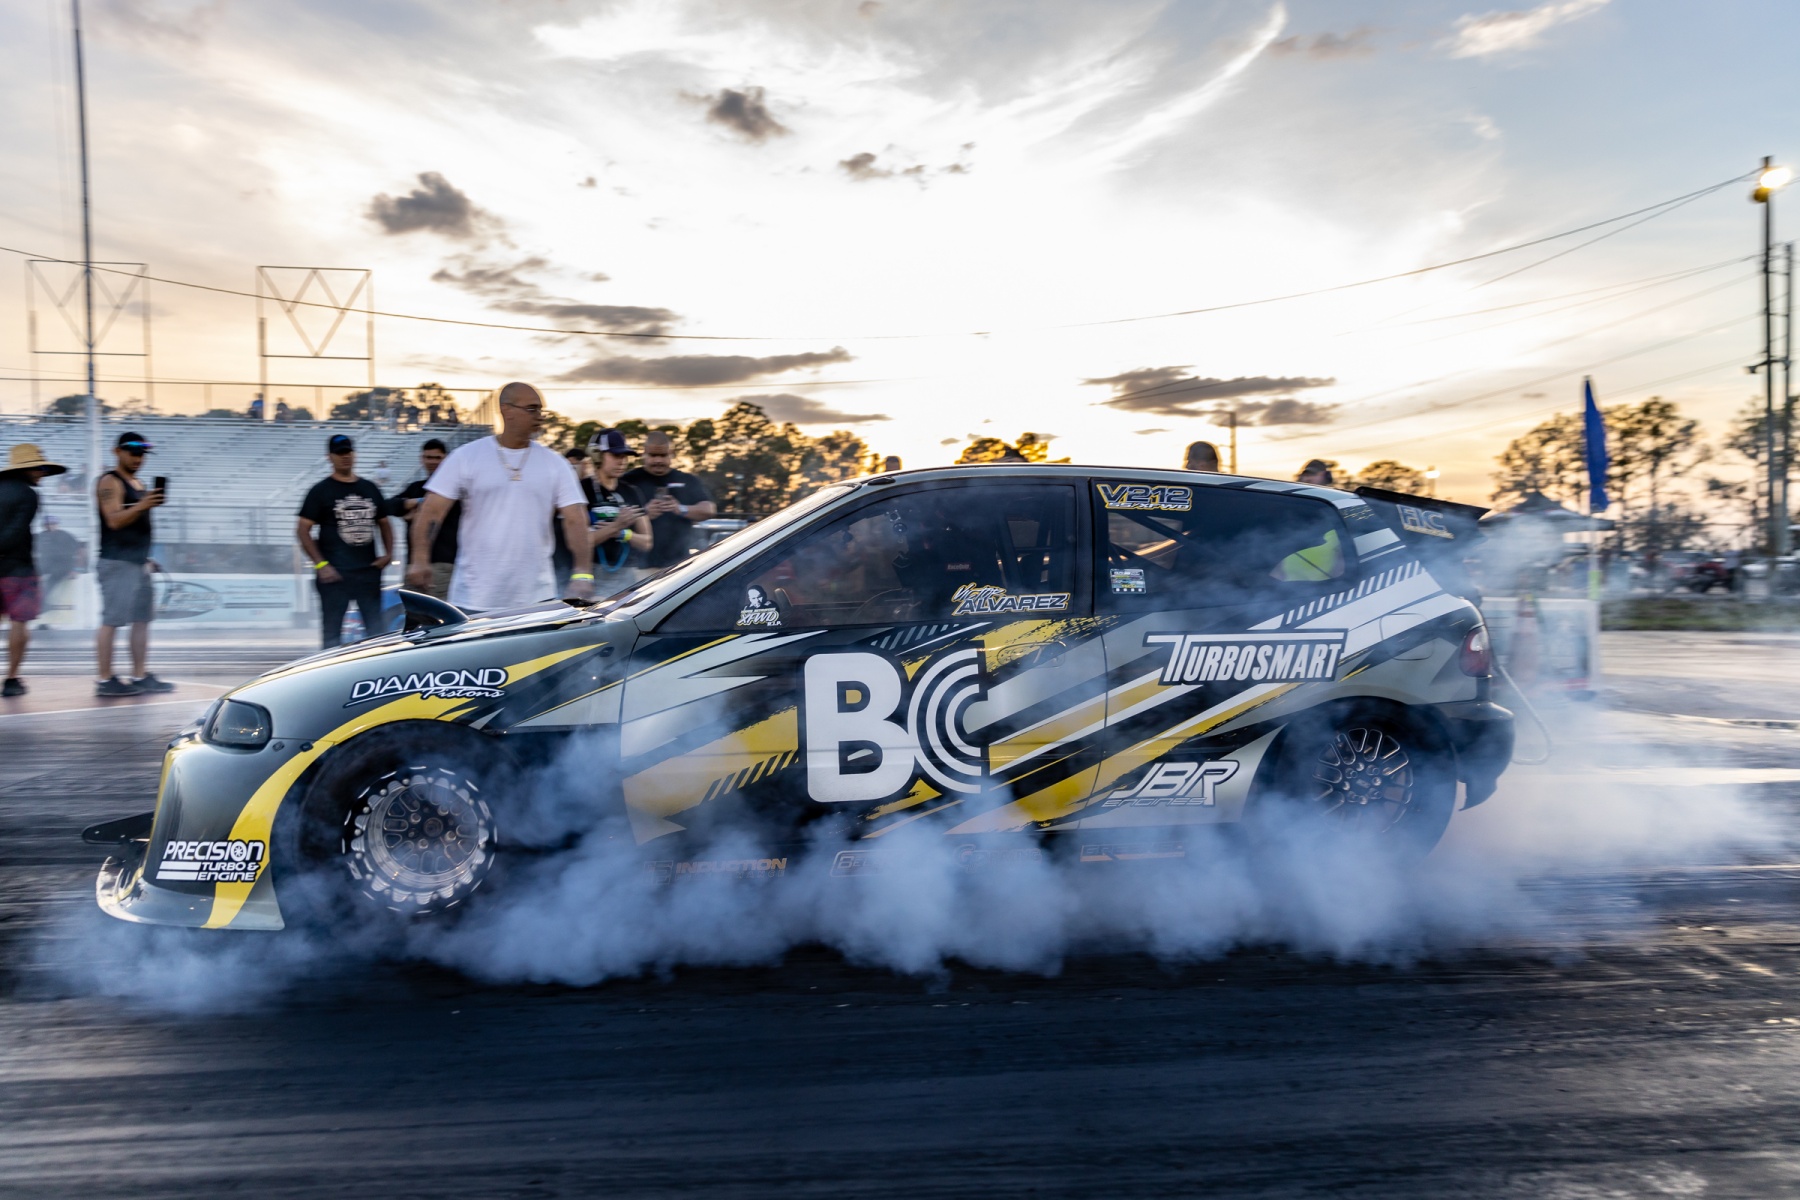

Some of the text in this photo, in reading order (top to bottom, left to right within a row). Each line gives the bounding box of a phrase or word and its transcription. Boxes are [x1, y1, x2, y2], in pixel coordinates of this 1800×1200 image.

[1098, 484, 1192, 504] V212
[954, 593, 1070, 615] ALVAREZ
[738, 611, 778, 624] XFWD
[1146, 632, 1344, 682] TURBOSMART
[352, 668, 507, 699] DIAMOND
[421, 687, 505, 699] Pistons
[804, 648, 982, 802] BC
[1107, 761, 1239, 806] JBR
[1101, 797, 1208, 808] ENGINES
[163, 841, 264, 862] PRECISION
[201, 862, 259, 871] TURBO &
[676, 858, 787, 873] INDUCTION
[198, 872, 255, 881] ENGINE
